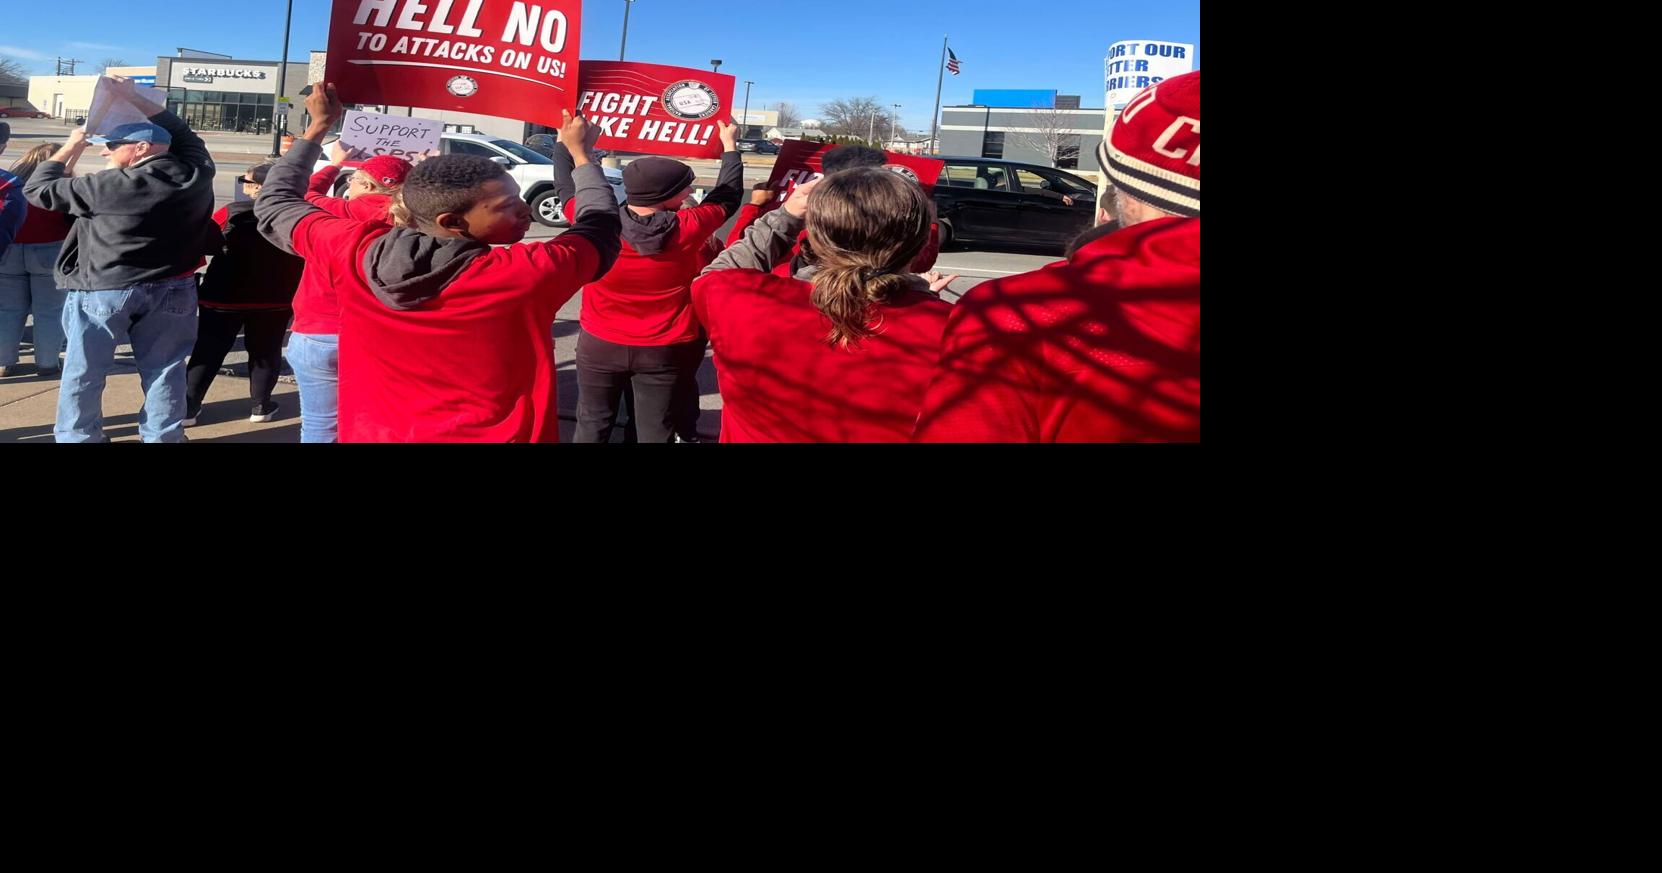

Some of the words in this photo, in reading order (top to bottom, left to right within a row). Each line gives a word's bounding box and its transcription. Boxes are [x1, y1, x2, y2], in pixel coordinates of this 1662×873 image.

[352, 0, 484, 38] HELL
[501, 1, 567, 53] NO
[356, 31, 388, 52] TO
[391, 35, 495, 64] ATTACKS
[500, 49, 531, 71] ON
[536, 55, 567, 79] US!
[1145, 43, 1186, 59] OUR
[183, 67, 262, 79] STARBUCKS
[1106, 59, 1149, 77] TTER
[576, 91, 658, 117] FIGHT
[350, 116, 431, 139] SUPPORT
[637, 119, 715, 146] HELL!
[375, 137, 401, 147] THE
[1152, 115, 1200, 166] C
